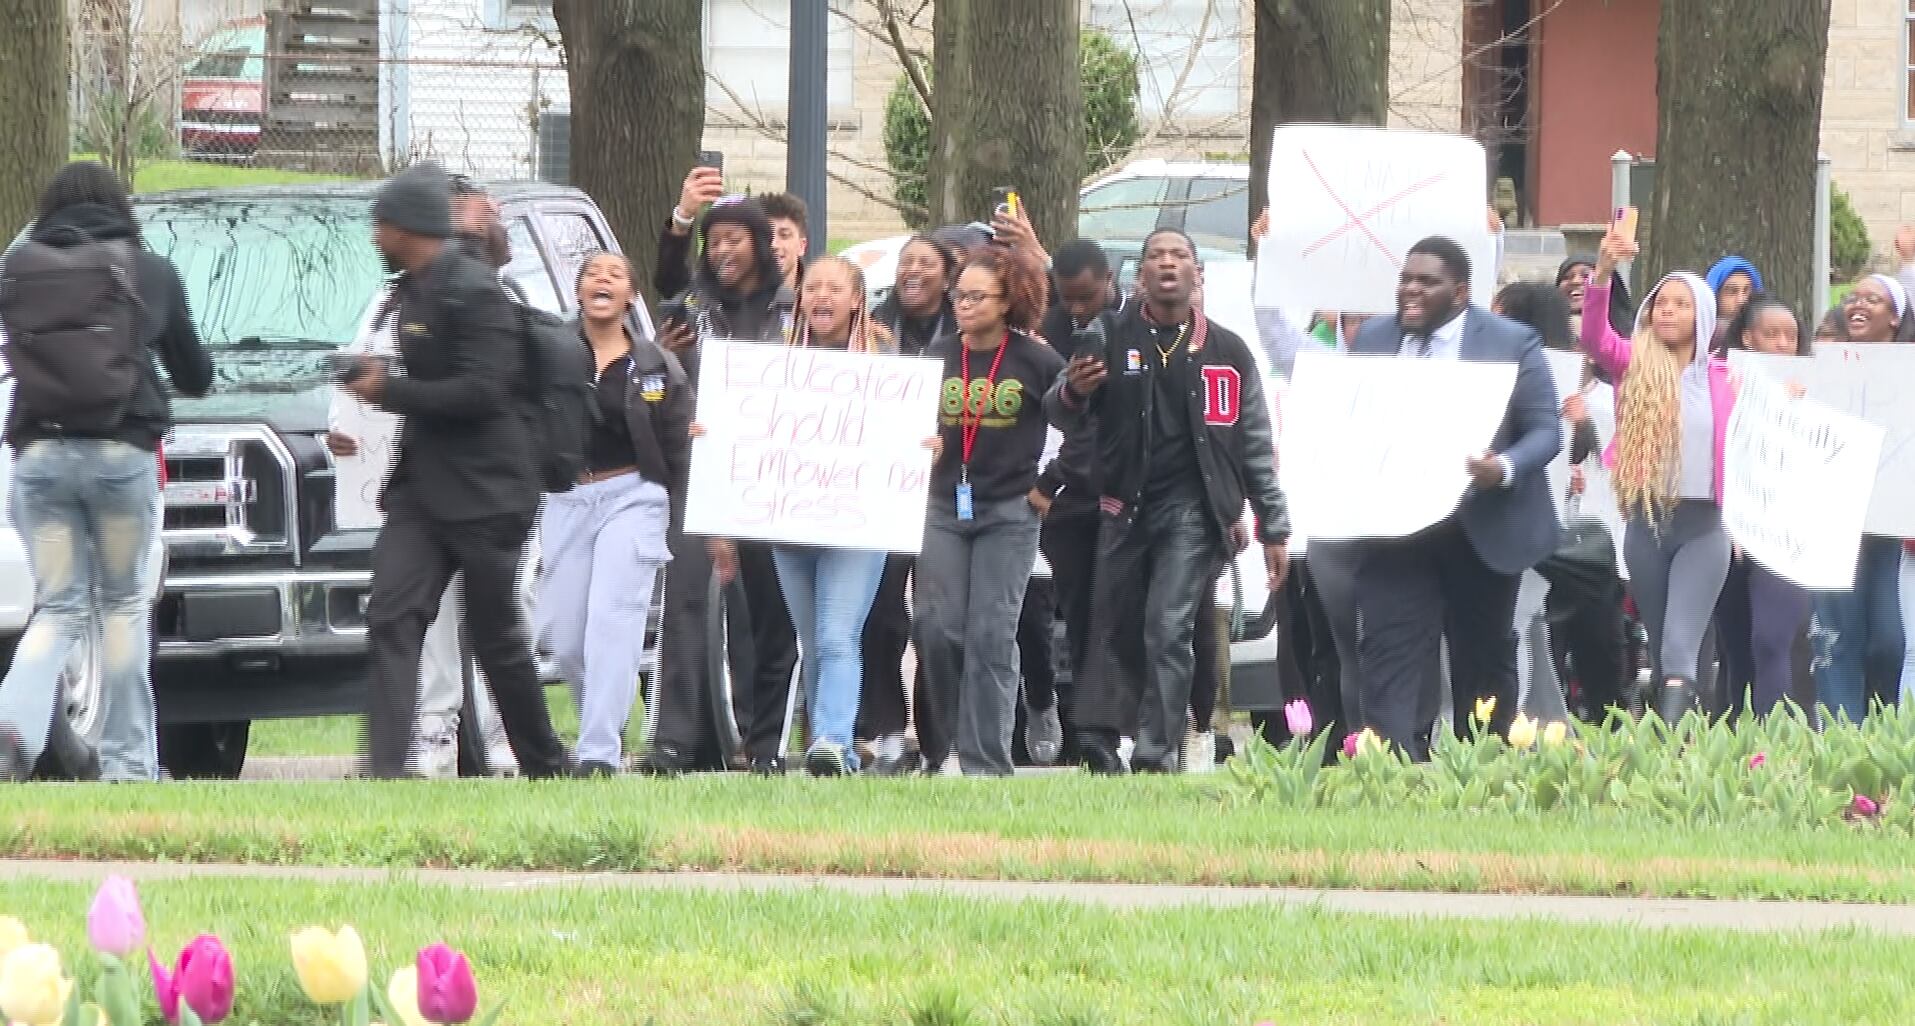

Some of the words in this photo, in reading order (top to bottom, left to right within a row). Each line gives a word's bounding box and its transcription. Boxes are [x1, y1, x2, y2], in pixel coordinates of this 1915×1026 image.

[724, 345, 924, 401] Education
[1200, 365, 1241, 426] D
[737, 393, 867, 447] Should
